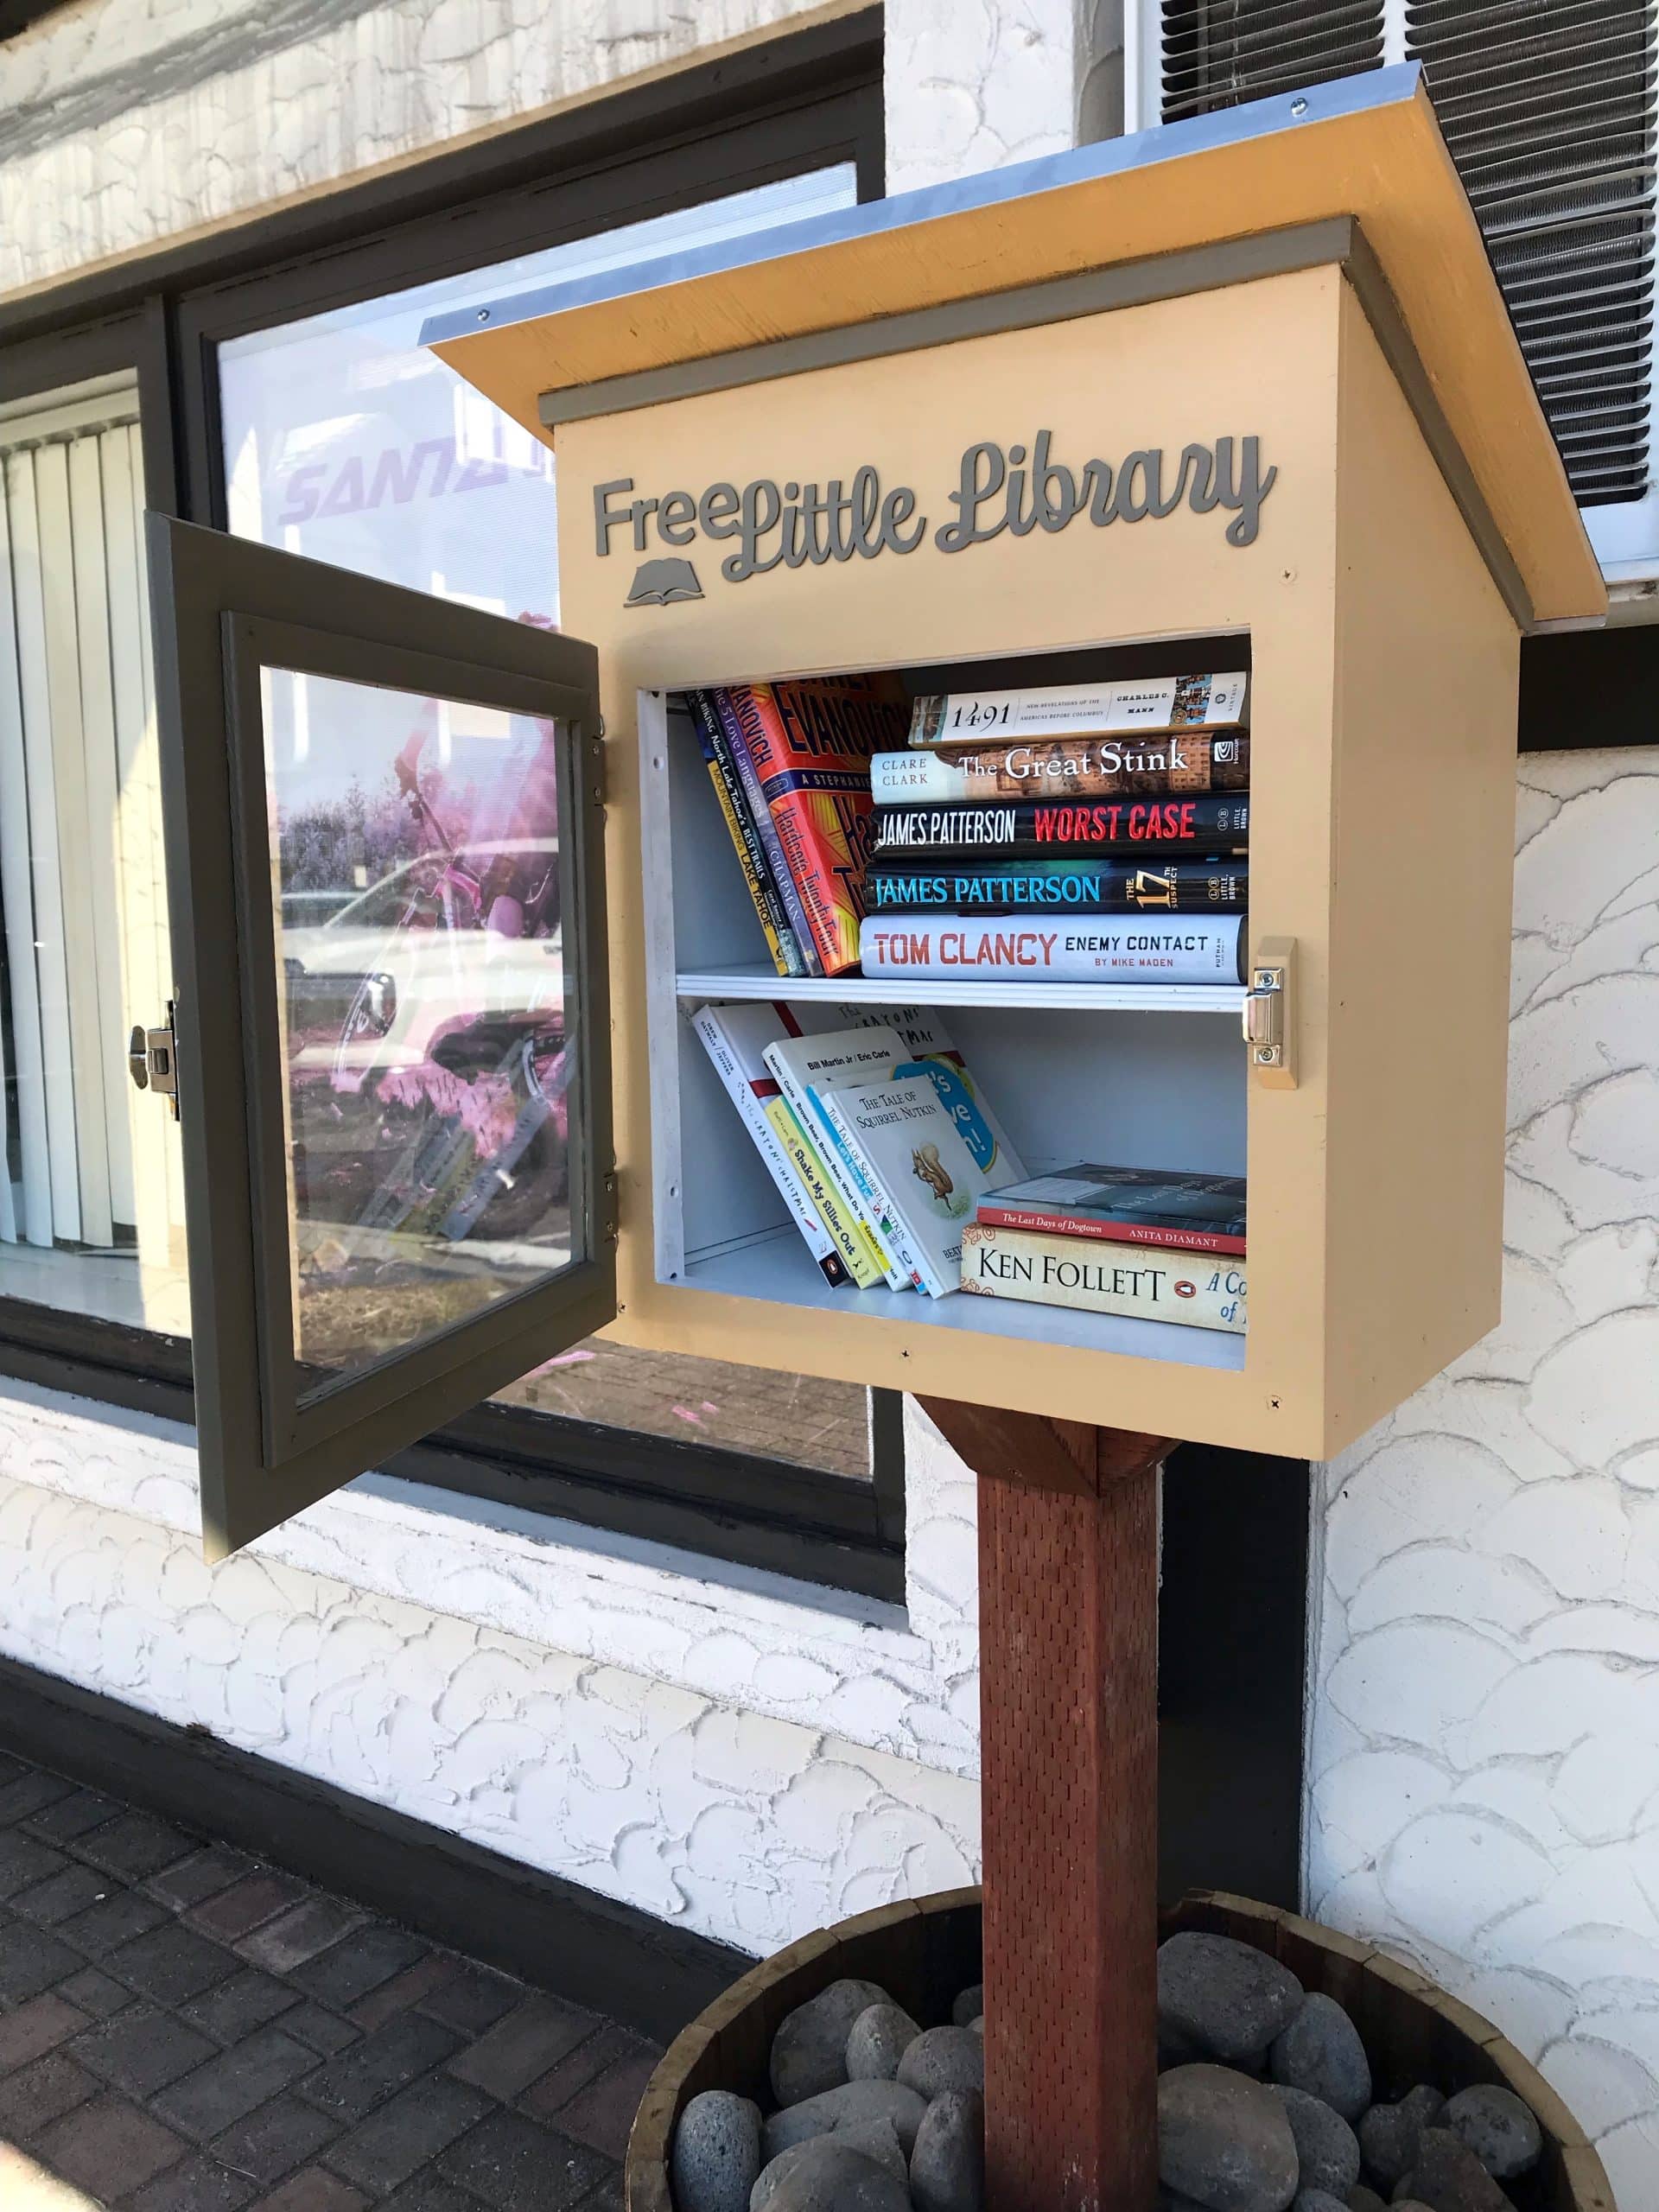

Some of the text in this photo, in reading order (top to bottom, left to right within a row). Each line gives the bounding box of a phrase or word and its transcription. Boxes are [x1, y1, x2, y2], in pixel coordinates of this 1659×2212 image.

[593, 429, 1278, 582] Free Little Library
[1117, 693, 1160, 702] CHARLES
[951, 701, 1010, 733] 1491
[715, 688, 766, 818] he 5 Love Languages
[882, 758, 927, 771] CLARE
[958, 737, 1189, 779] The Great Stink
[701, 702, 766, 880] BIKING North Lake Tahoe's BEST TRAILS
[801, 773, 810, 785] A
[882, 773, 928, 786] CLARK
[878, 813, 926, 846] JAMES
[931, 810, 1016, 844] PATTERSON
[1034, 804, 1122, 842] WORST
[1129, 803, 1197, 841] CASE
[712, 769, 734, 818] MOUNTAIN
[729, 818, 745, 851] BIKING
[741, 854, 756, 887] LAKE
[753, 887, 772, 930] TAHOE
[774, 807, 807, 875] Hardcore
[798, 871, 830, 924] Twenty
[771, 851, 800, 922] CHAPMAN
[875, 877, 948, 906] JAMES
[955, 875, 1101, 903] PATTERSON
[1126, 879, 1135, 900] THE
[874, 933, 1209, 966] TOM CLANCY ENEMY CONTACT
[1140, 958, 1173, 967] MADEN
[807, 1061, 821, 1071] Bill
[821, 1058, 844, 1068] Martin
[845, 1055, 853, 1064] Jr
[857, 1052, 872, 1062] Eric
[873, 1050, 891, 1059] Carle
[856, 1103, 938, 1128] SQUIRREL NUTKIN
[859, 1090, 918, 1111] THE TALE OF
[770, 1054, 783, 1077] Martin
[784, 1081, 795, 1098] Carle
[796, 1103, 810, 1124] Brown
[809, 1124, 819, 1142] Bear,
[818, 1142, 832, 1164] Brown
[831, 1164, 842, 1183] Bear,
[842, 1182, 854, 1201] What
[852, 1200, 859, 1211] Do
[829, 1107, 840, 1126] THE
[839, 1126, 853, 1148] TALE
[851, 1149, 861, 1161] OF
[858, 1161, 884, 1205] SQUIRREL
[884, 1205, 906, 1241] NUTKIN
[849, 1162, 863, 1186] Have
[795, 1148, 855, 1255] Shake My Sillies Out
[1002, 1213, 1103, 1234] The Last Days of Dogtown
[1129, 1230, 1218, 1248] ANITA DIAMANT
[942, 1245, 962, 1259] BEAT
[979, 1247, 1033, 1283] KEN
[1043, 1256, 1166, 1301] FOLLETT
[1205, 1273, 1220, 1292] A
[1220, 1301, 1238, 1322] of
